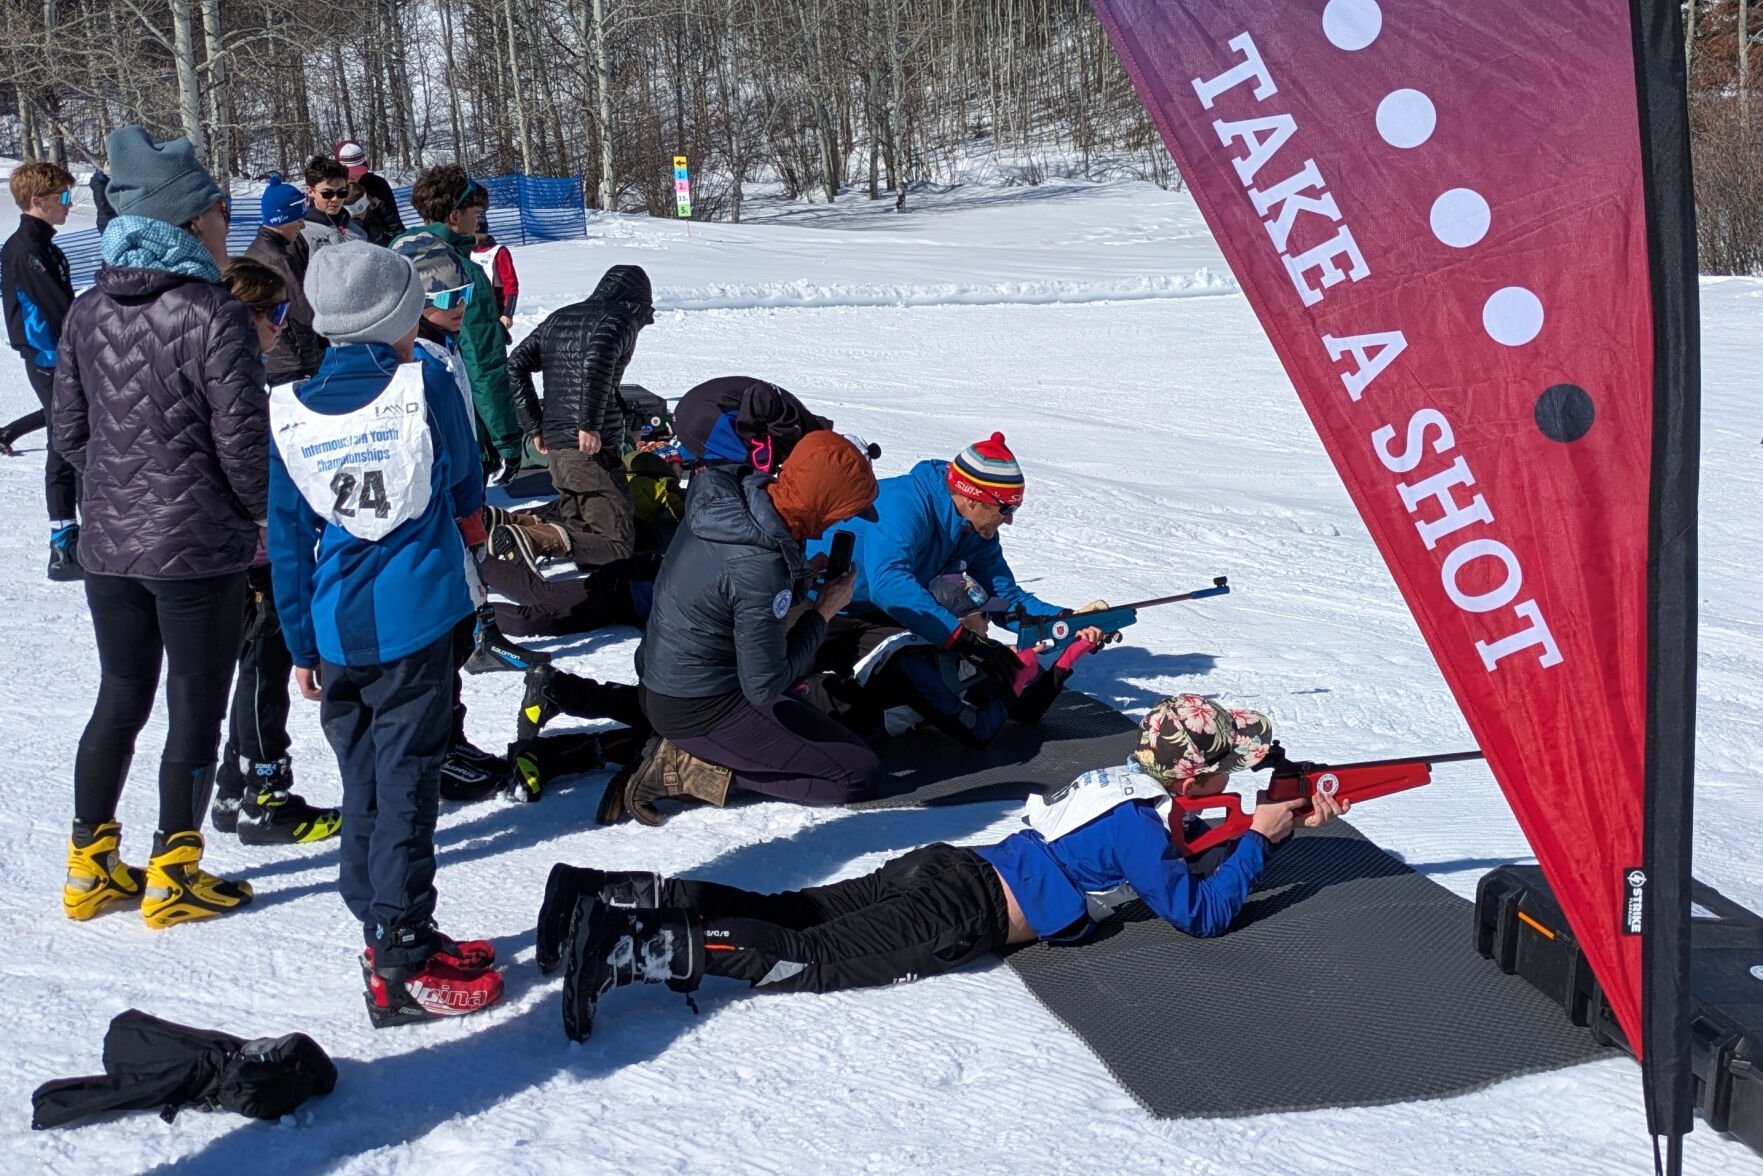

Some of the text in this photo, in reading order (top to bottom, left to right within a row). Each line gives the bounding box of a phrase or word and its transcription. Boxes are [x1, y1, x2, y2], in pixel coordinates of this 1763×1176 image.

[1192, 31, 1564, 673] TAKE A SHOT
[369, 429, 399, 445] Youth
[329, 470, 391, 519] 24
[1631, 887, 1643, 933] STRIKE
